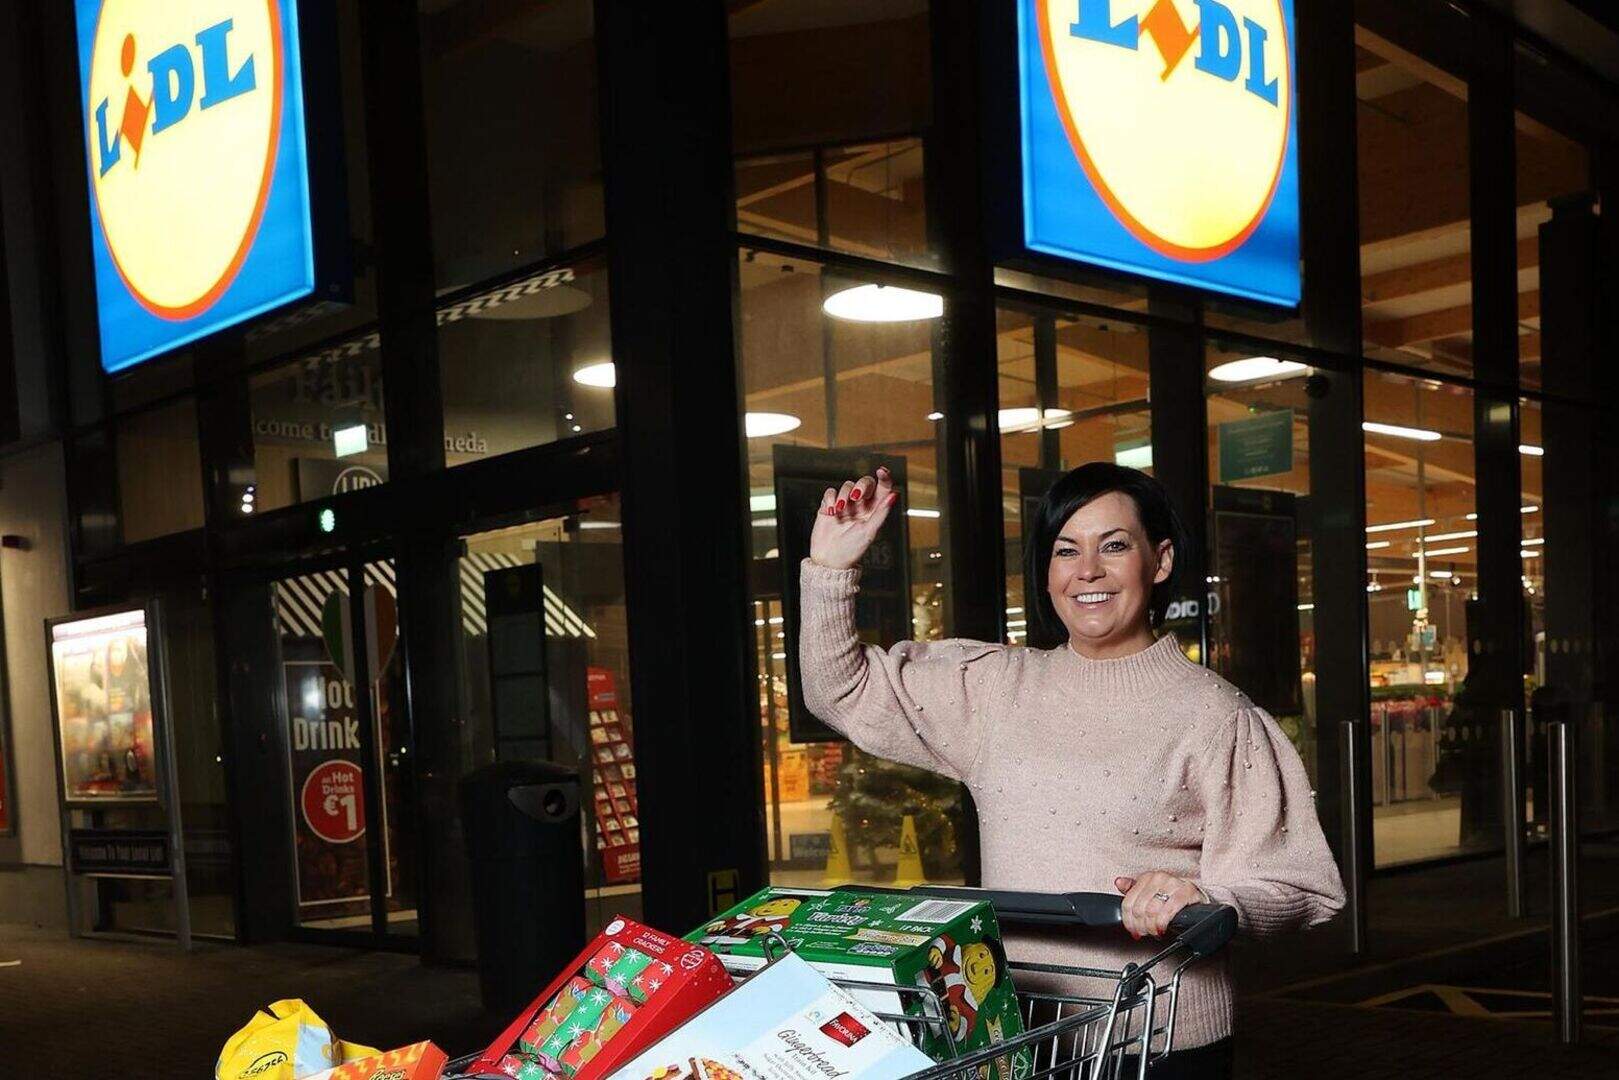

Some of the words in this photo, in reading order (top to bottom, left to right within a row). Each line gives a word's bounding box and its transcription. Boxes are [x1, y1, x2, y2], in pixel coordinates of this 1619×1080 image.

[444, 431, 488, 453] neda
[293, 716, 361, 751] Drink
[323, 794, 358, 831] €1
[633, 937, 666, 955] CRACKERS
[648, 934, 672, 946] FAMILY
[777, 1029, 849, 1080] Gingerbread
